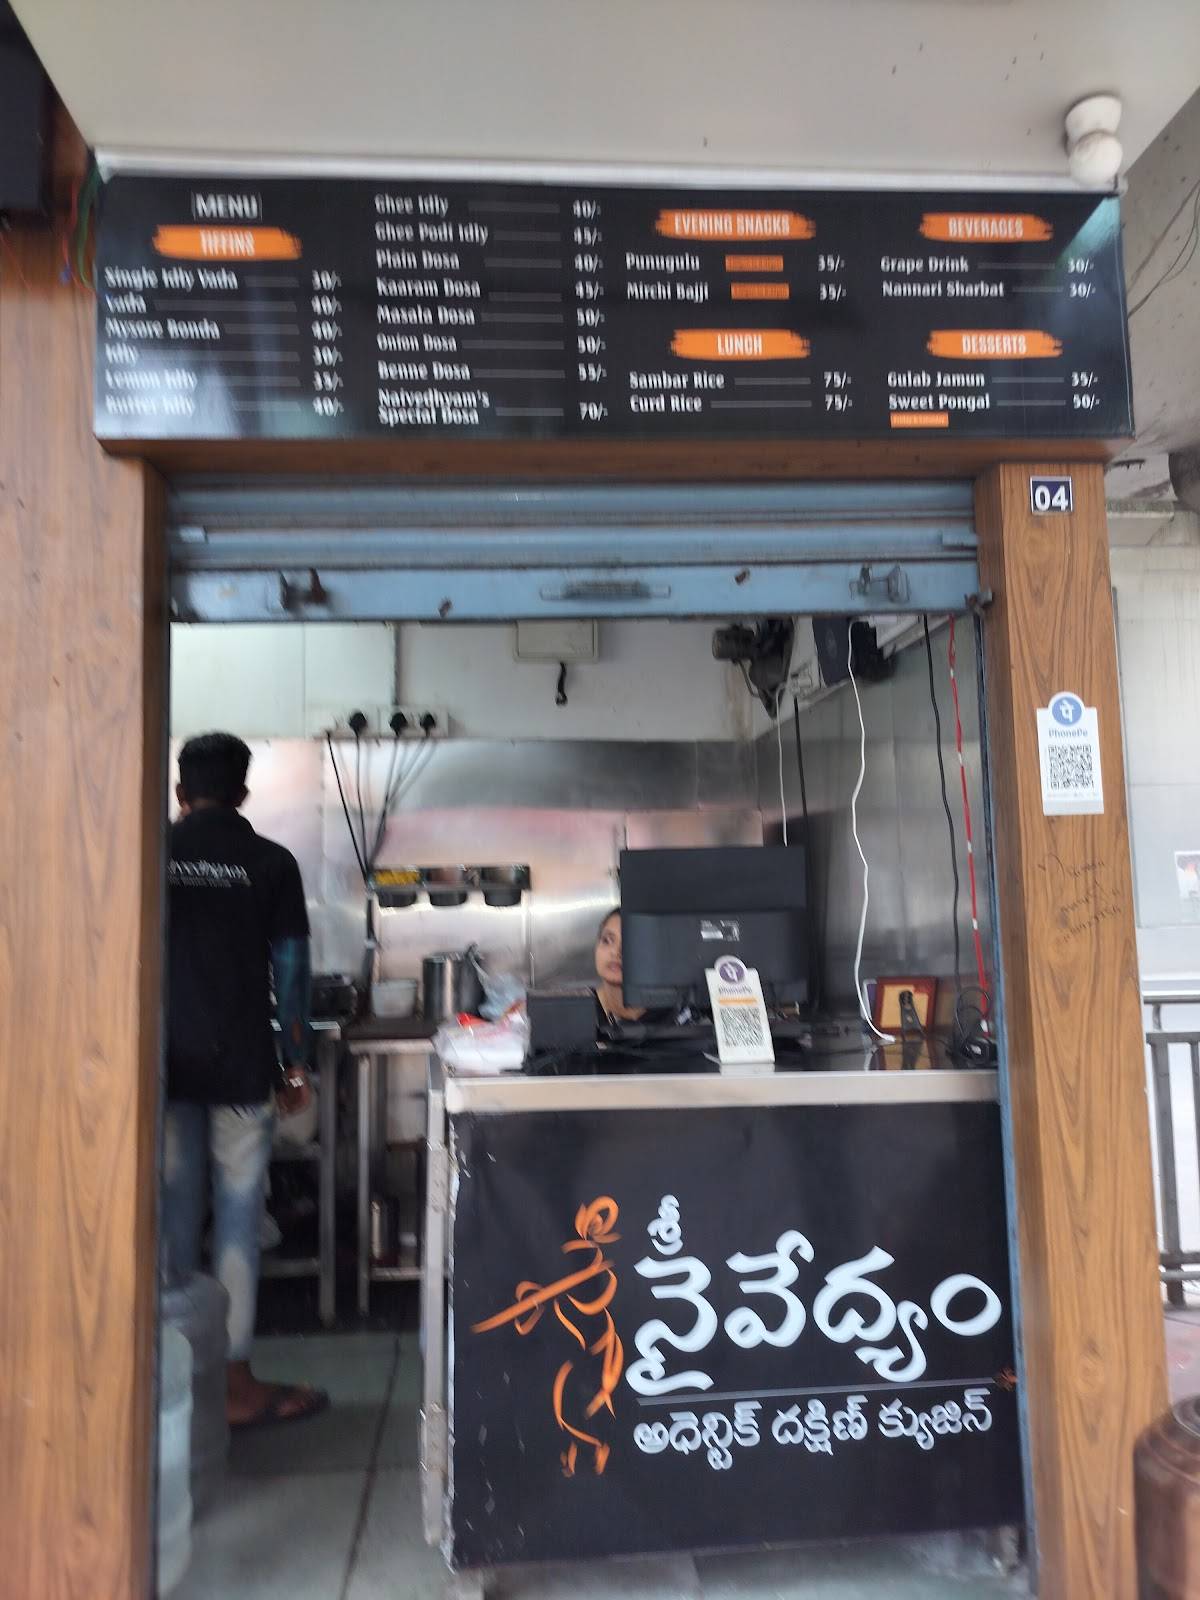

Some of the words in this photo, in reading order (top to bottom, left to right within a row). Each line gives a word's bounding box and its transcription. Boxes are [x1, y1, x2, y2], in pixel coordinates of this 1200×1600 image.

[195, 194, 259, 219] MENU
[375, 194, 413, 214] Ghee
[419, 195, 448, 218] Idly
[375, 221, 413, 242] Ghee
[419, 222, 453, 242] Podi
[459, 223, 488, 246] Idly
[675, 214, 732, 235] EVENING
[736, 214, 790, 236] SNACKS
[949, 218, 1023, 238] BEVERAGES
[201, 230, 254, 256] TIFFINS
[376, 249, 417, 269] Plain
[422, 250, 459, 270] Dosa
[626, 252, 699, 274] Punugulu
[881, 257, 923, 275] Grape
[929, 257, 968, 272] Drink
[105, 266, 158, 291] Single
[162, 267, 194, 291] Idly
[198, 269, 238, 289] Vada
[377, 277, 438, 297] Kaaram
[444, 278, 481, 298] Dosa
[883, 281, 942, 297] Nannari
[947, 281, 1003, 297] Sharbat
[627, 282, 671, 300] Mirchi
[677, 282, 708, 304] Bajji
[377, 305, 432, 325] Masala
[438, 306, 475, 325] Dosa
[106, 318, 163, 339] Mysore
[167, 319, 220, 339] Bonda
[377, 333, 419, 351] Onion
[423, 333, 457, 352] Dosa
[717, 334, 762, 356] LUNCH
[962, 335, 1026, 355] DESSERTS
[378, 361, 427, 380] Benne
[433, 361, 470, 380] Dosa
[630, 371, 688, 389] Sambar
[694, 371, 725, 389] Rice
[888, 372, 930, 387] Gulab
[936, 372, 985, 387] Jamun
[378, 388, 490, 409] Naivedhyam's
[630, 395, 665, 412] Curd
[671, 394, 702, 412] Rice
[889, 394, 933, 410] Sweet
[939, 394, 990, 412] Pongal
[379, 407, 437, 427] Special
[442, 406, 479, 425] Dosa
[1034, 485, 1069, 511] 04
[1048, 728, 1088, 738] PhonePe
[625, 1229, 1002, 1397] నైవేద్యం
